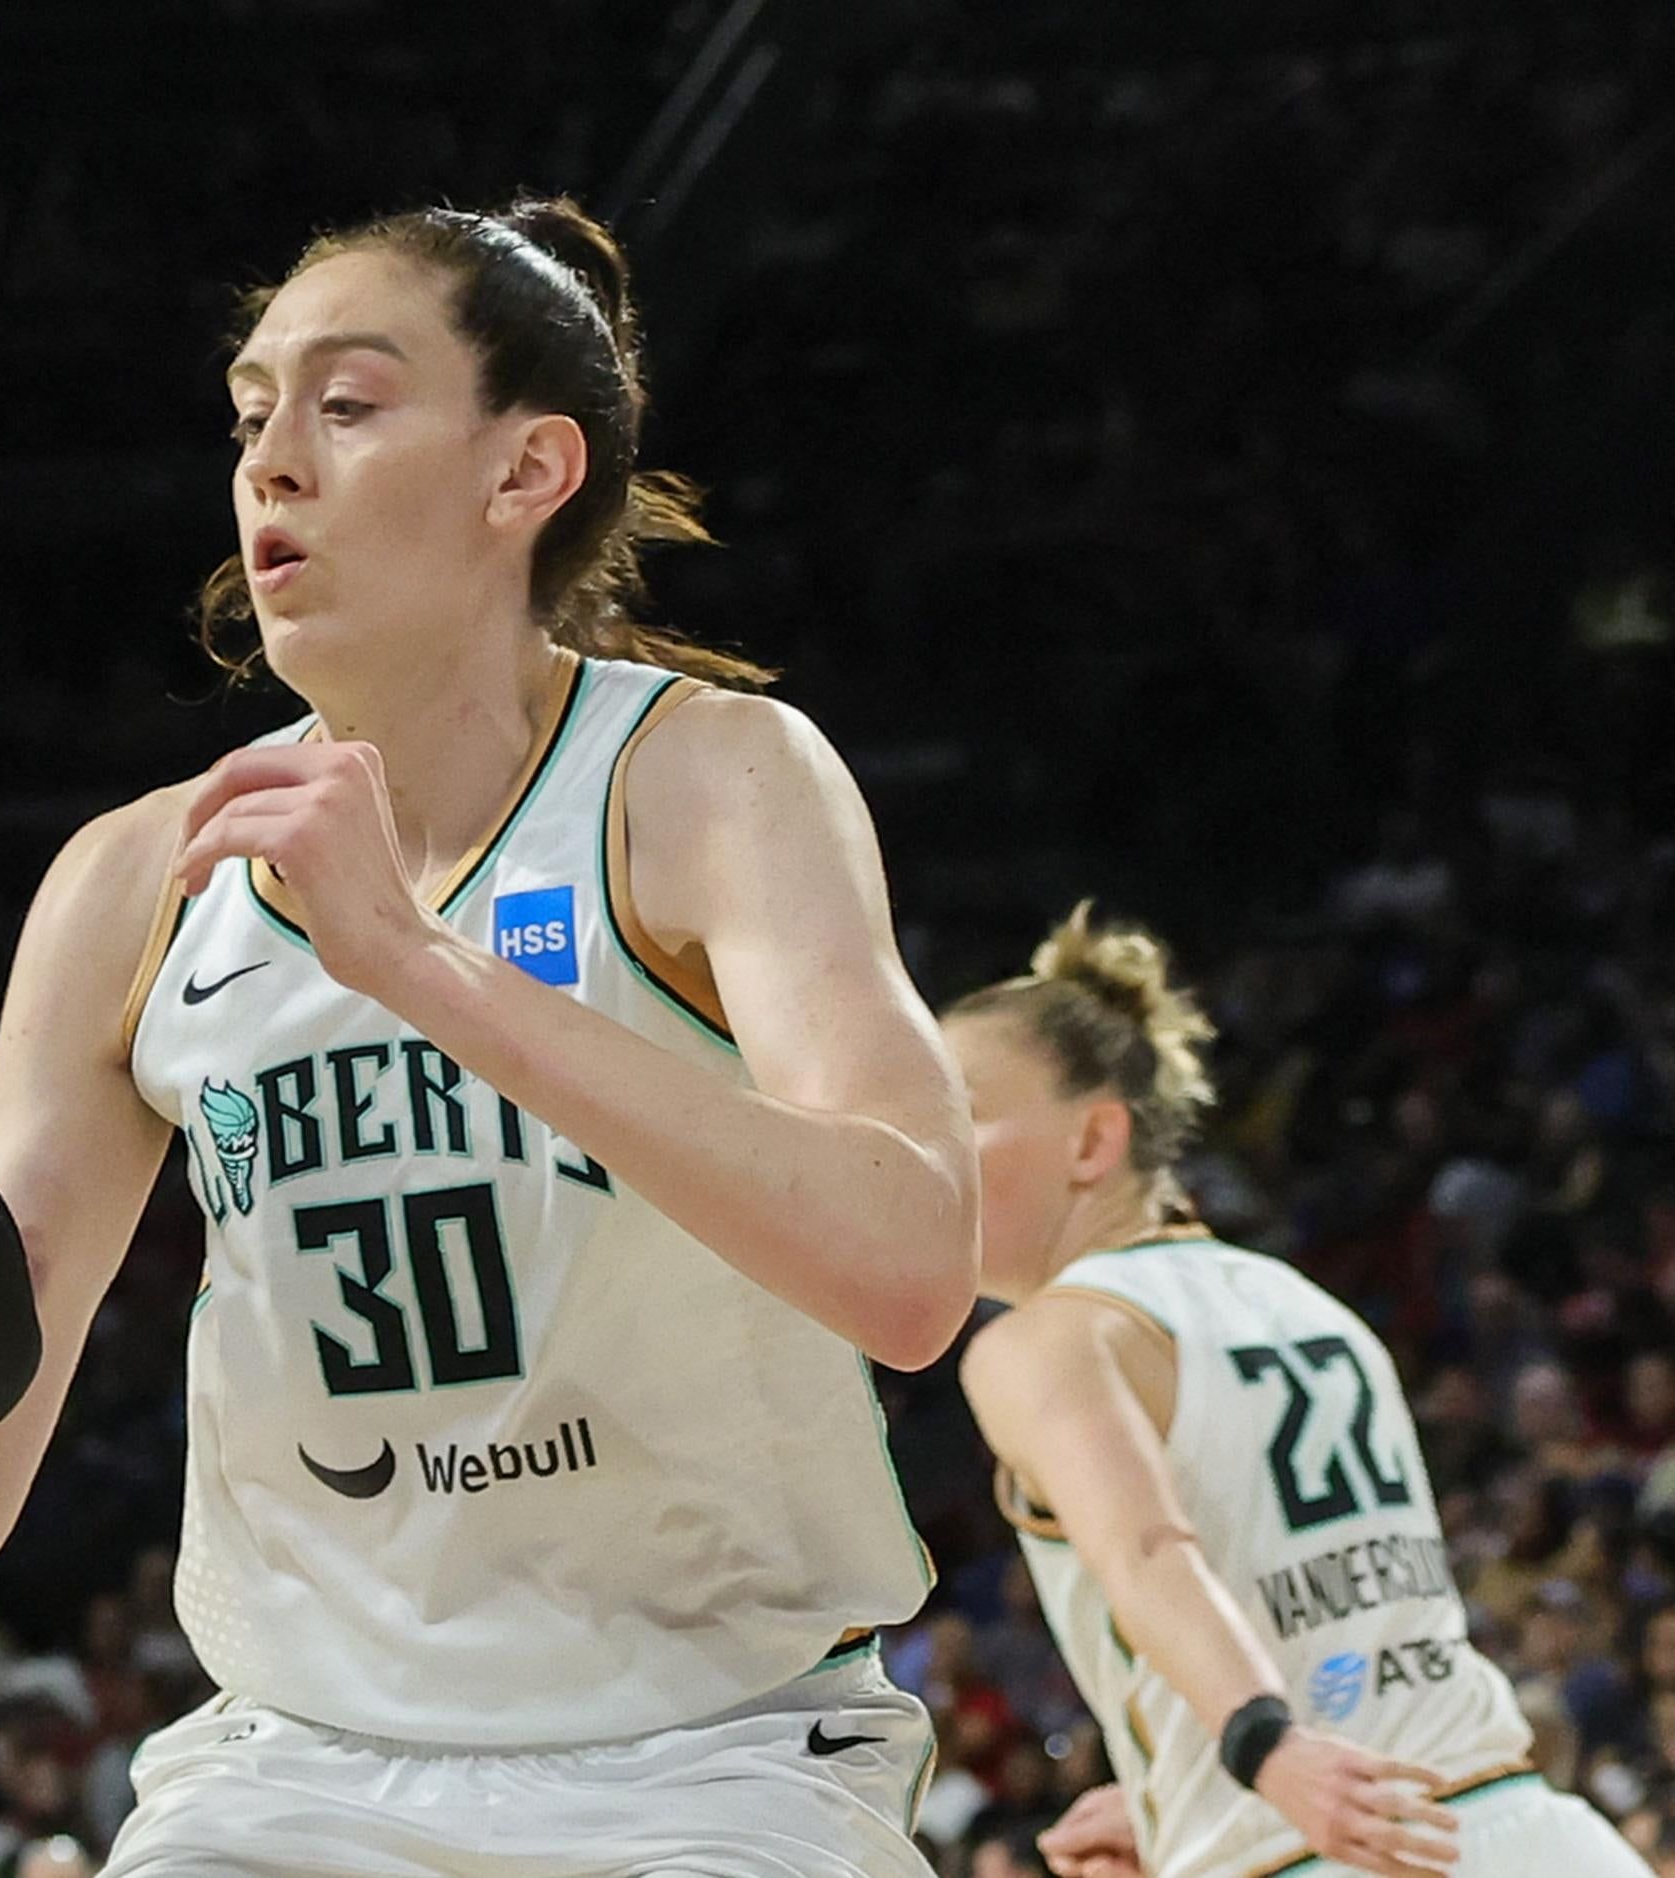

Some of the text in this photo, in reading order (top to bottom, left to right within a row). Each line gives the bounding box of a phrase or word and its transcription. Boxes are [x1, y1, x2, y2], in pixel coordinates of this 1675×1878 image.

[500, 920, 567, 959] HSS
[292, 1181, 526, 1398] 30
[416, 1417, 597, 1495] Webull
[1224, 1335, 1413, 1533] 22
[1375, 1638, 1467, 1697] AT&
